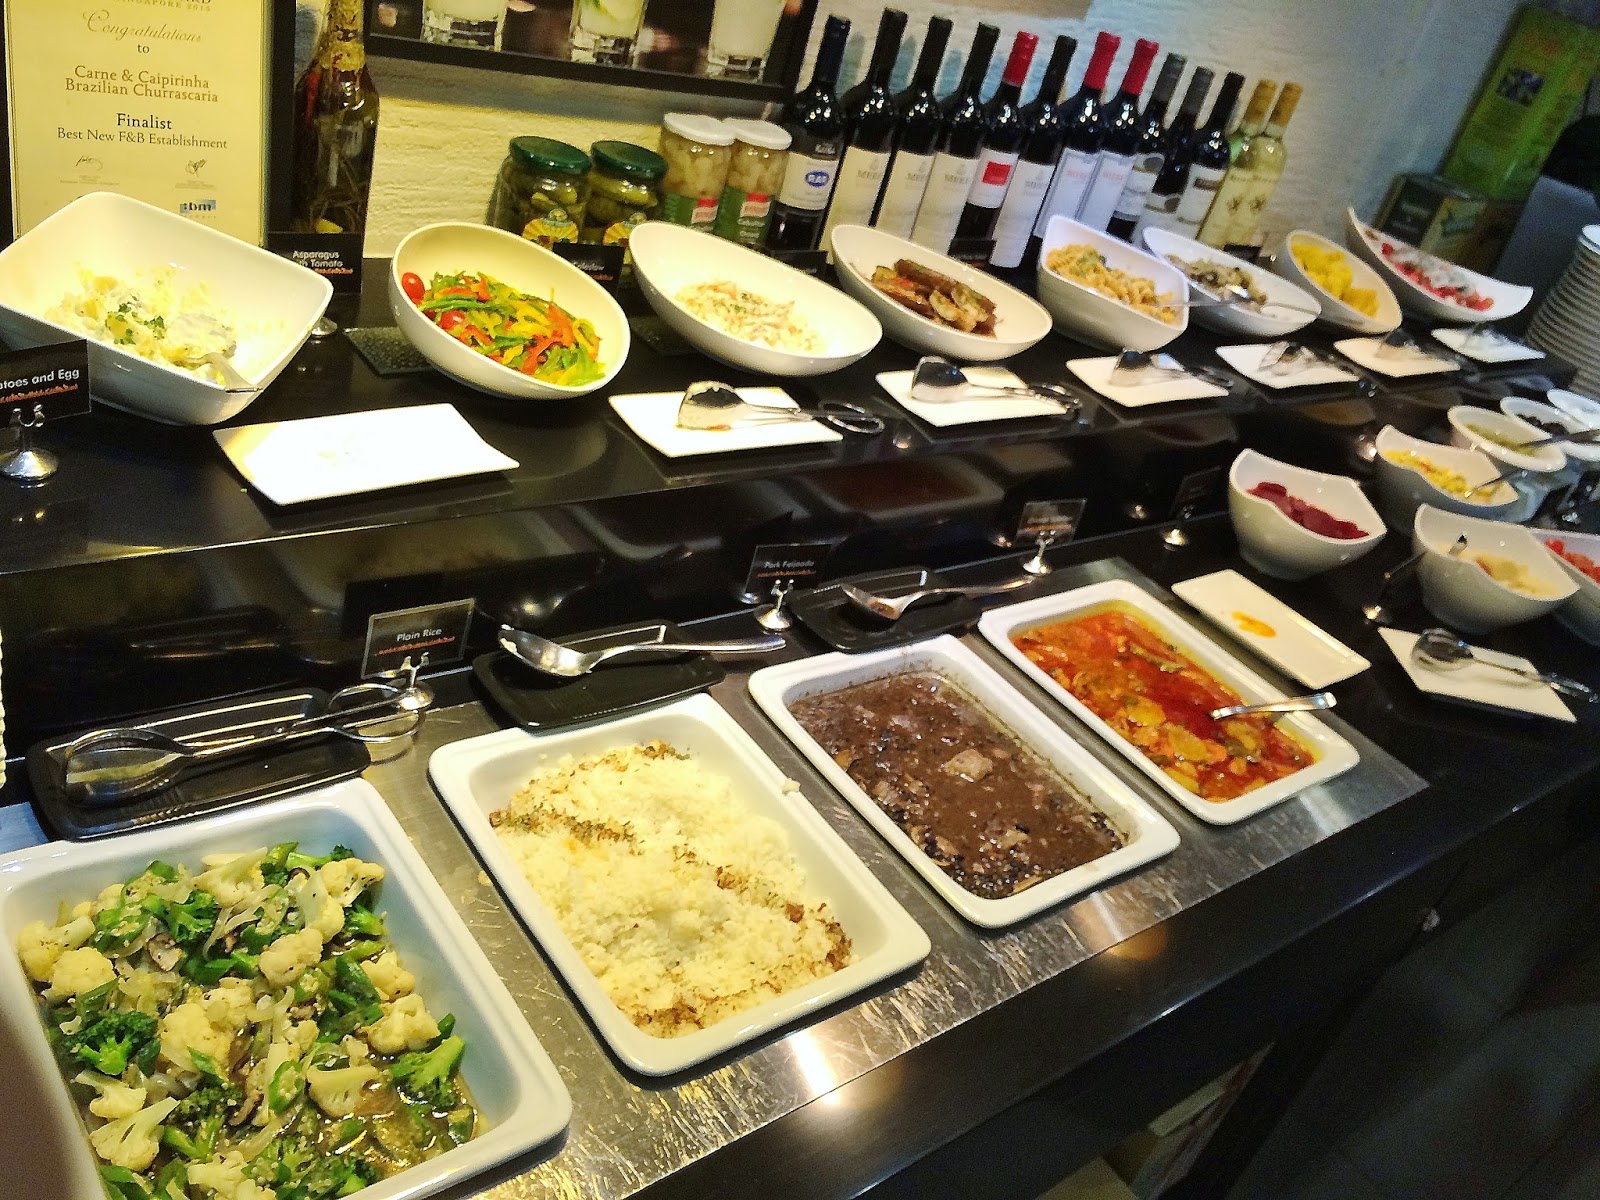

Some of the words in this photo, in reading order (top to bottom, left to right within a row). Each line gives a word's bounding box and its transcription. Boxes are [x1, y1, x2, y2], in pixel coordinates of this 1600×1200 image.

[82, 9, 202, 42] Congratulations
[137, 44, 150, 54] to
[74, 65, 117, 81] Carne
[121, 68, 133, 82] &
[138, 70, 210, 89] Caipirinha
[65, 78, 128, 95] Brazilian
[133, 84, 219, 102] Churrascaria
[116, 112, 173, 130] Finalist
[57, 127, 83, 140] Best
[87, 129, 115, 142] New
[119, 131, 145, 144] F&B
[149, 133, 228, 149] Establishment
[292, 250, 340, 260] Asparagus
[311, 259, 344, 268] Tomato
[31, 370, 55, 385] and
[57, 368, 80, 381] Egg
[396, 632, 421, 642] Plain
[422, 627, 443, 637] Rice
